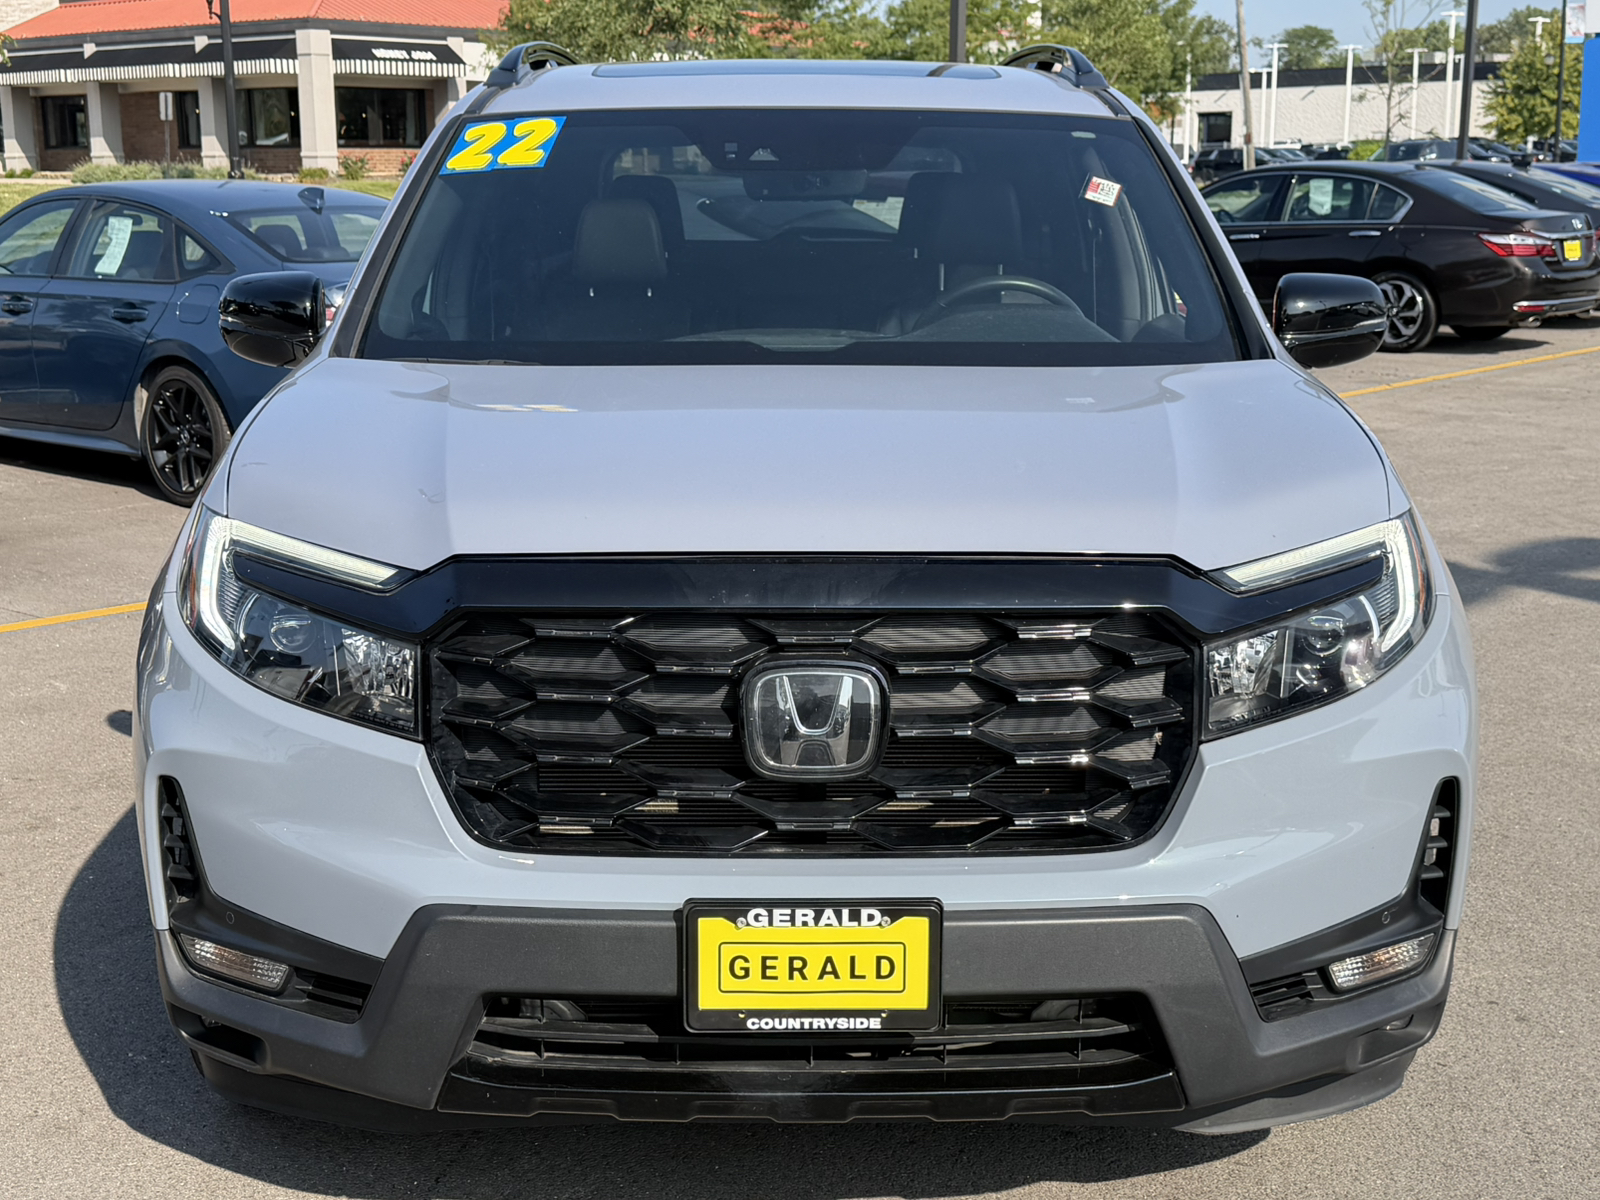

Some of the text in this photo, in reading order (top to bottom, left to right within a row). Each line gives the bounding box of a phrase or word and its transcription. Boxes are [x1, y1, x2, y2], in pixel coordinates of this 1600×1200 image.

[446, 118, 558, 170] 22
[746, 908, 882, 928] GERALD
[728, 955, 896, 981] GERALD
[746, 1017, 882, 1030] COUNTRYSIDE
